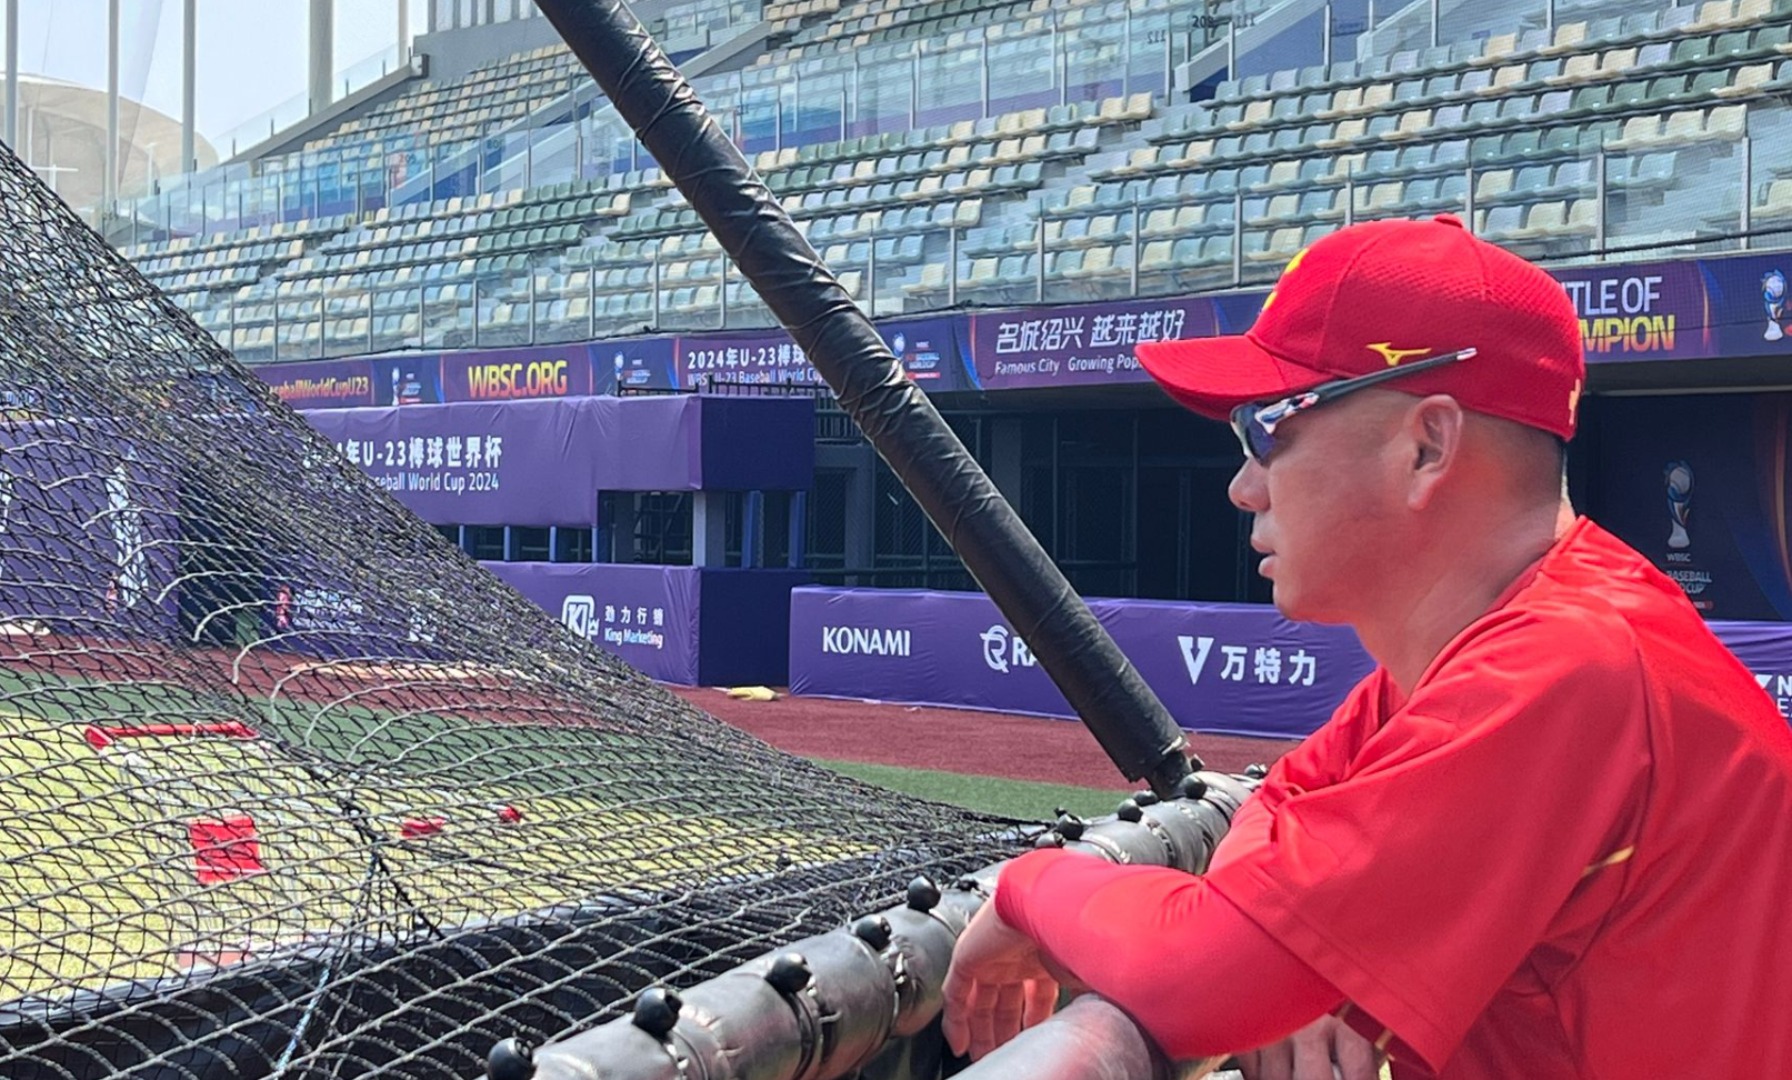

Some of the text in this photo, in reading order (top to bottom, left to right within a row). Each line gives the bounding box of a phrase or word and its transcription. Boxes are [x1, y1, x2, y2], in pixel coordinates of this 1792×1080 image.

[1563, 276, 1662, 316] TLE OF
[996, 310, 1186, 354] 名城绍兴 越来越好
[687, 344, 812, 370] 2024年U-23棒球
[995, 353, 1142, 376] Famous City Growing Pop
[468, 360, 568, 398] WBSC.ORG
[408, 472, 440, 491] World
[444, 472, 465, 495] Cup
[469, 472, 499, 491] 2024
[604, 627, 664, 649] King Marketing
[822, 626, 911, 656] KONAMI
[1220, 645, 1316, 687] 万特力
